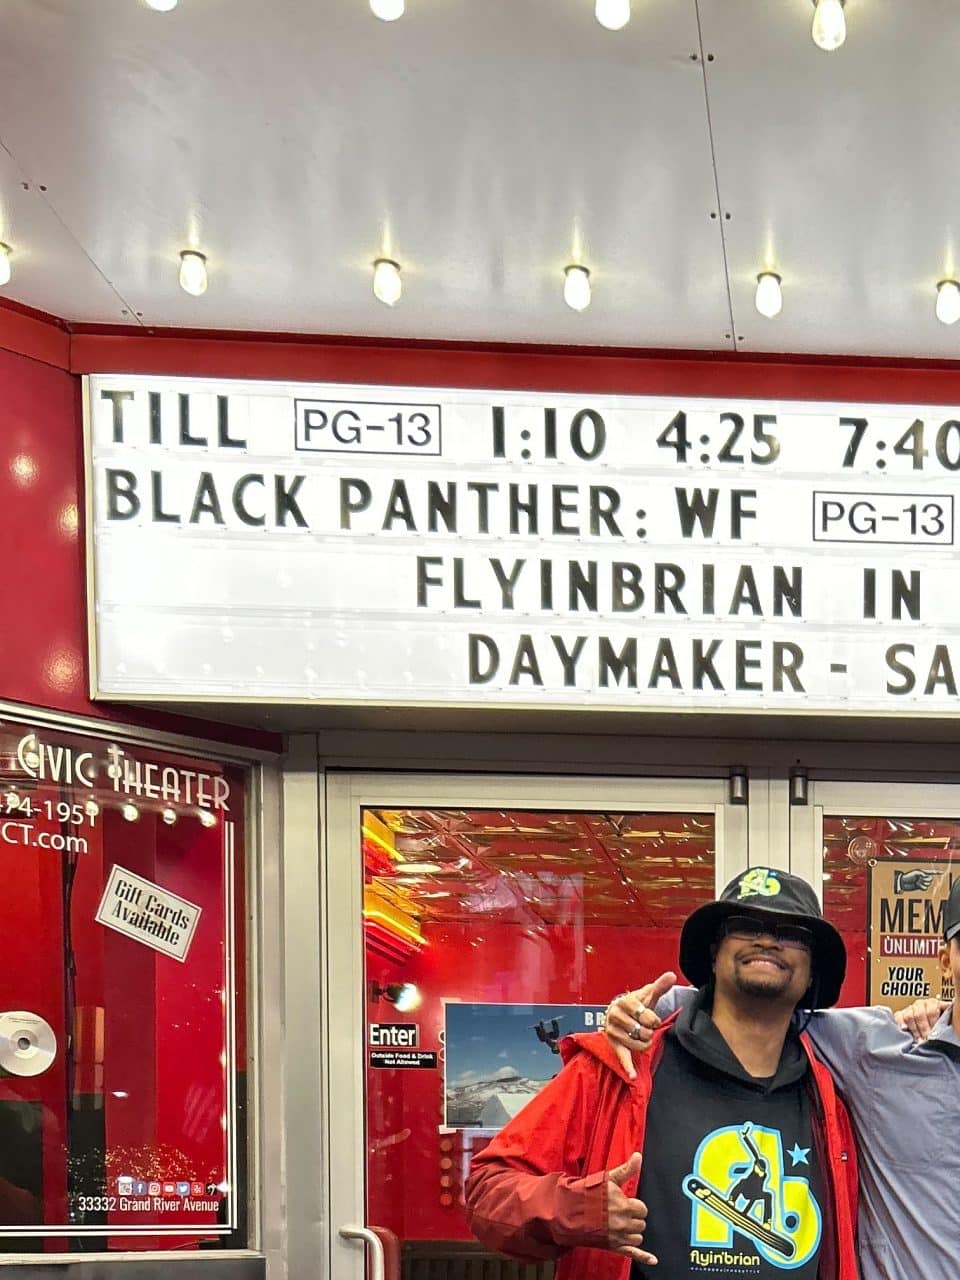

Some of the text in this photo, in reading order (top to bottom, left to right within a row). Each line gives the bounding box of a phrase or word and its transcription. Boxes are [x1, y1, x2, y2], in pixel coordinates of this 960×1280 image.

[101, 390, 247, 448] TILL
[303, 408, 432, 446] PG-13
[492, 406, 606, 461] 1:10
[656, 410, 781, 466] 4:25
[105, 468, 309, 528] BLACK
[339, 478, 647, 538] PANTHER:
[676, 487, 757, 539] WF
[822, 501, 945, 536] PG-13
[417, 556, 802, 617] FLYINBRIAN
[864, 568, 921, 621] IN
[468, 633, 806, 693] DAYMAKER
[17, 734, 230, 811] CIVIC THEATER
[112, 900, 180, 946] Available
[114, 879, 190, 930] Gift Cards
[881, 982, 930, 997] CHOICE
[888, 966, 924, 982] YOUR
[370, 1024, 415, 1046] Enter
[78, 1197, 219, 1212] 33332 Grand River Avenue
